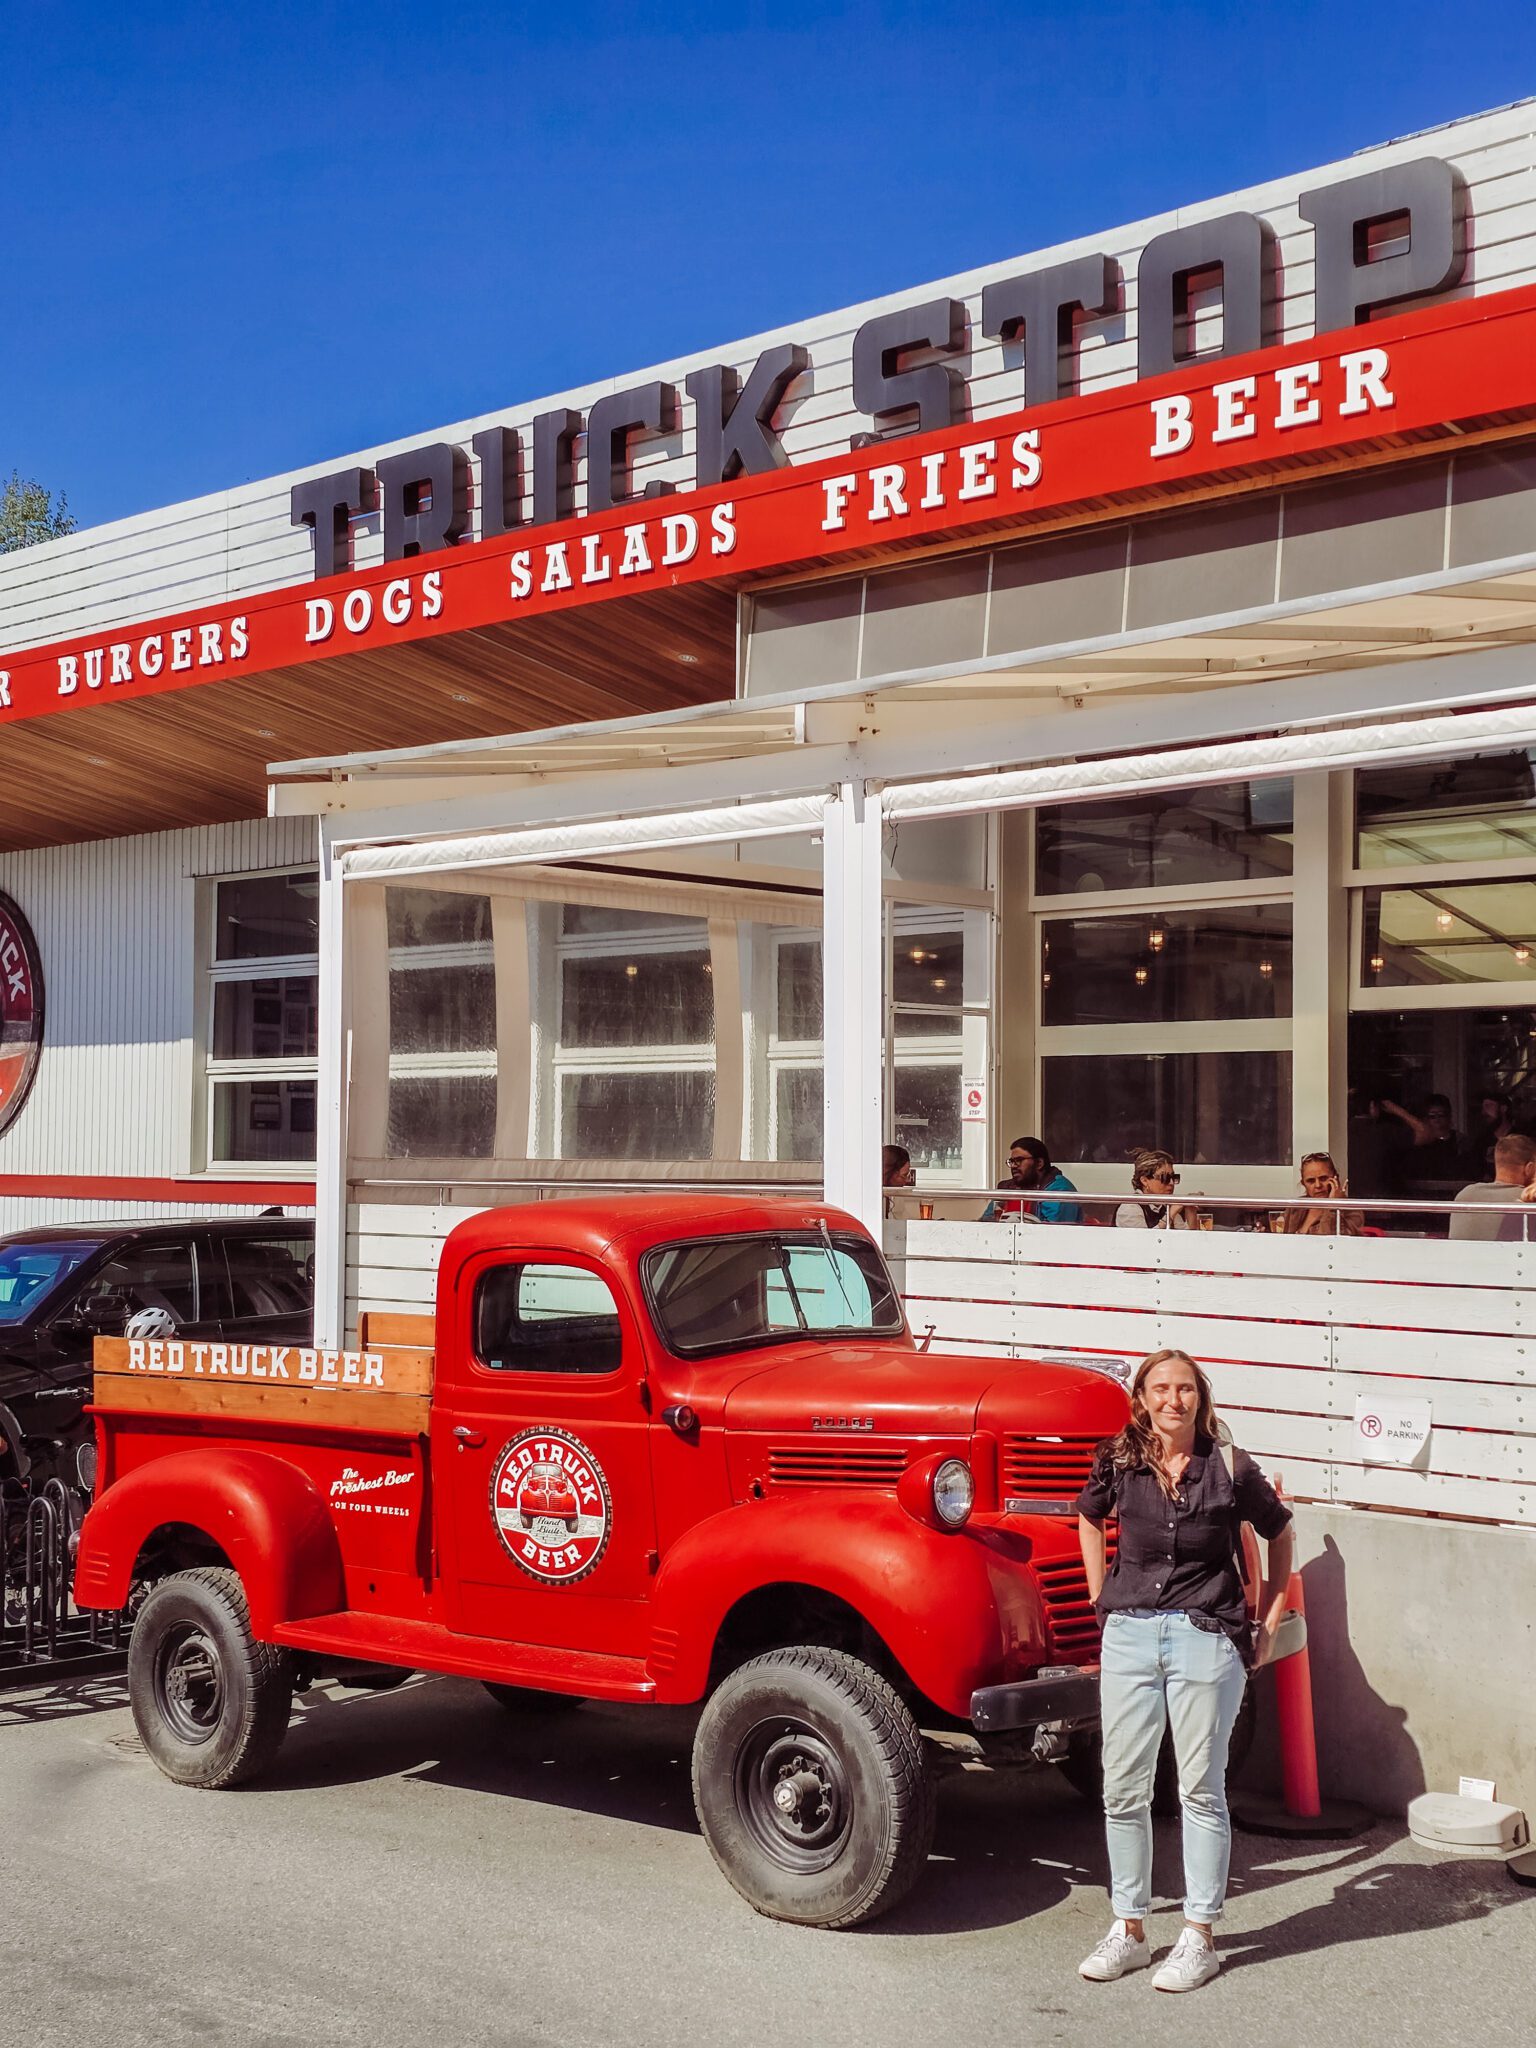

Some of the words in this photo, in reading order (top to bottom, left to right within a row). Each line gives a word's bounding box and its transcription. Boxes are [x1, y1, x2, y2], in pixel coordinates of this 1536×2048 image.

[291, 342, 808, 580] TRUCK
[850, 156, 1468, 453] STOP
[57, 616, 250, 696] BURGERS
[305, 571, 445, 643] DOGS
[510, 502, 738, 599] SALADS
[821, 429, 1042, 532] FRIES
[1150, 348, 1396, 458] BEER
[128, 1340, 184, 1373] RED
[190, 1343, 290, 1379] TRUCK
[298, 1348, 385, 1387] BEER
[811, 1416, 874, 1430] DODGE
[1400, 1420, 1413, 1429] NO
[1387, 1429, 1424, 1441] PARKING
[329, 1476, 383, 1496] Freshest
[384, 1470, 415, 1486] Beer
[342, 1467, 359, 1480] The
[500, 1448, 533, 1498] RED
[534, 1442, 598, 1505] TRUCK
[349, 1502, 372, 1513] FOUR
[374, 1505, 410, 1517] WHEELS
[536, 1516, 562, 1526] Hand
[521, 1538, 582, 1568] BEER
